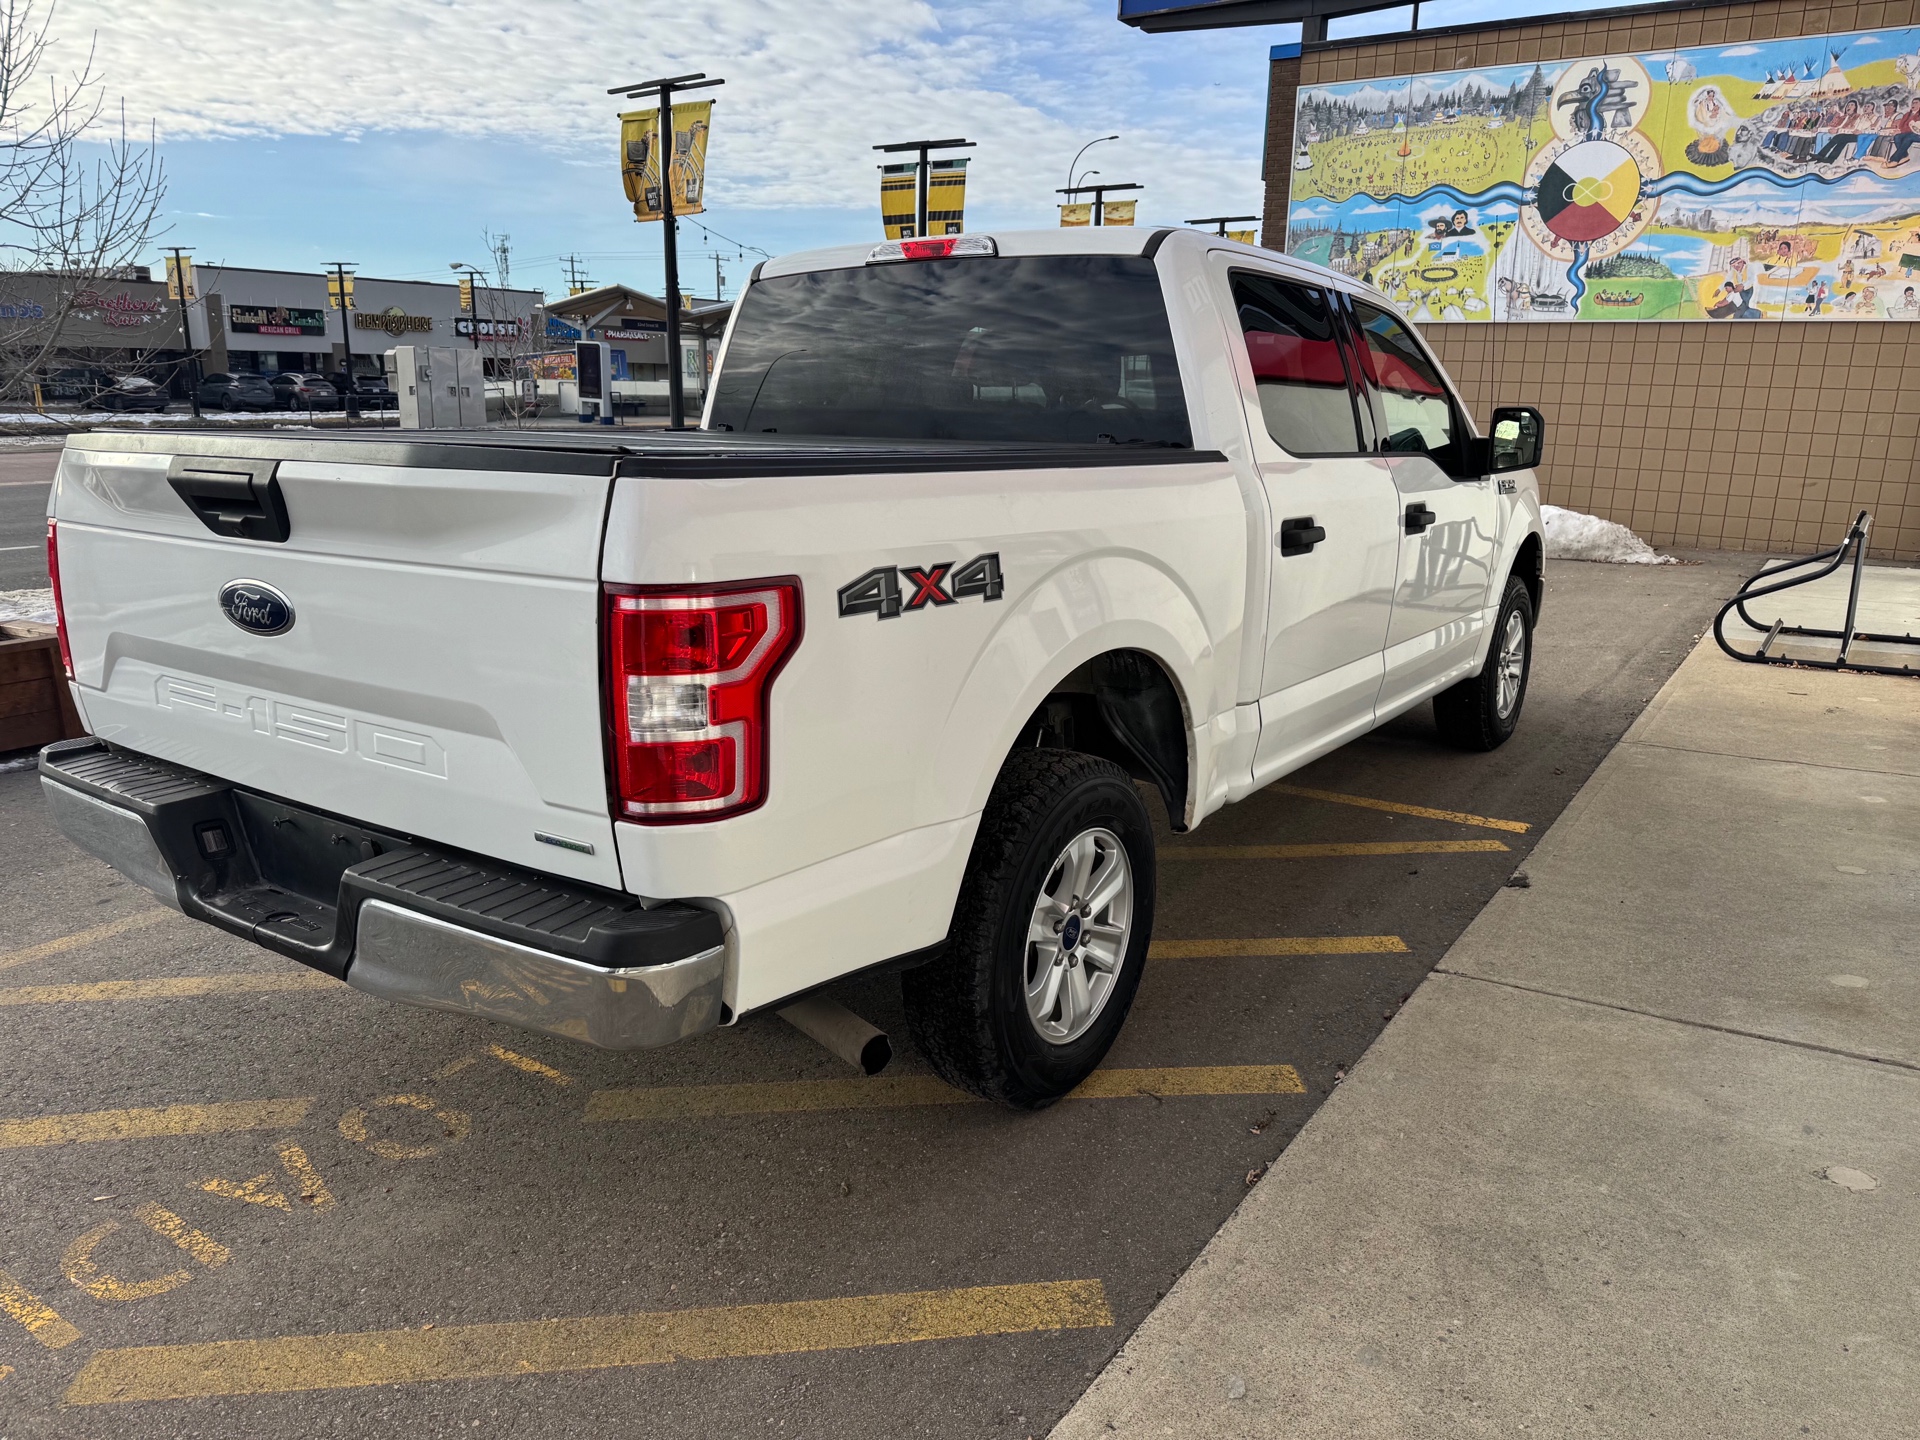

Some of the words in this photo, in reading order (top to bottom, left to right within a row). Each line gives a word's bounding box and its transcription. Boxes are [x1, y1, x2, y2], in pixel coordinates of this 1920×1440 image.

[260, 326, 285, 334] MEXICAN
[232, 590, 272, 625] Ford
[154, 674, 448, 779] F-150
